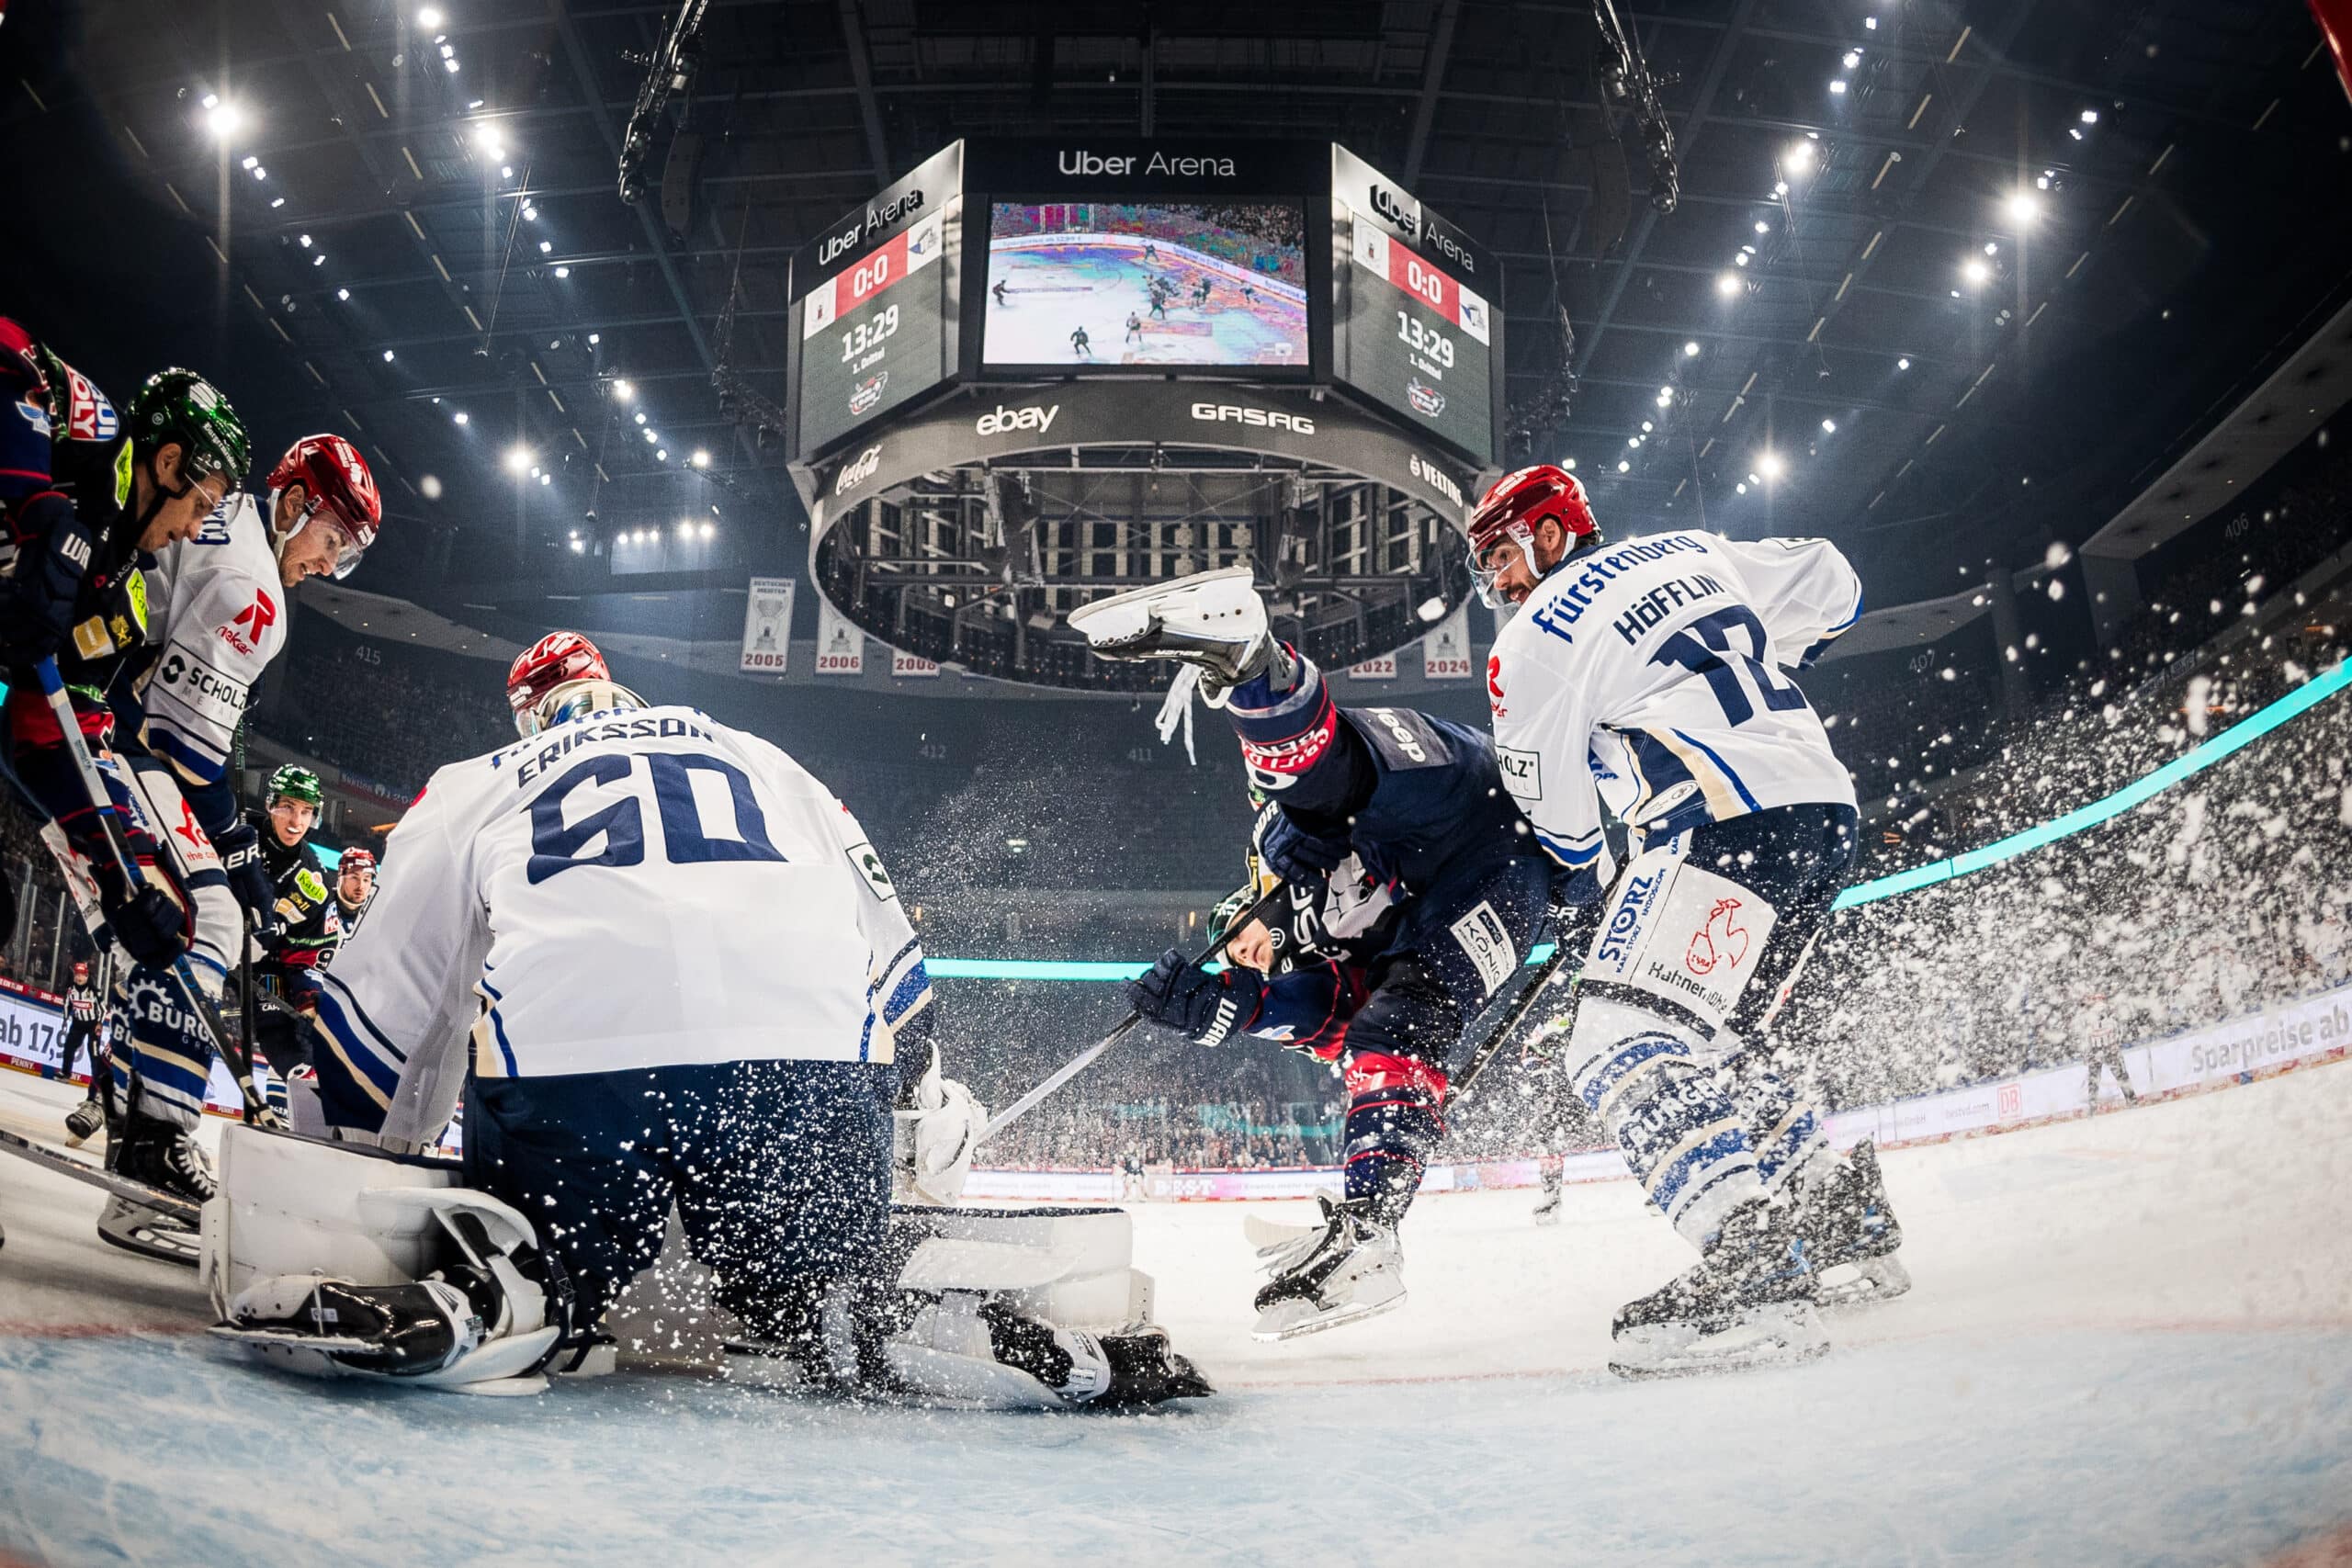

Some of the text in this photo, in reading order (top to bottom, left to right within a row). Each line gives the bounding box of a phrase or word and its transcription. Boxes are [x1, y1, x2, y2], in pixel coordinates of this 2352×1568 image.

[1058, 151, 1236, 175] Uber Arena
[819, 189, 923, 265] Uber Arena
[1371, 184, 1475, 273] Uber Arena
[853, 254, 888, 299] 0:0
[1408, 260, 1442, 305] 0:0
[842, 304, 899, 363] 13:29
[1397, 310, 1454, 368] 13:29
[74, 375, 96, 438] OLY
[976, 405, 1059, 435] ebay
[1191, 403, 1315, 434] GASAG
[1421, 459, 1464, 507] VELTINS
[2224, 513, 2250, 540] 406
[1612, 573, 1725, 646] HÖFFLIN
[356, 645, 381, 665] 415
[744, 653, 784, 667] 2005
[820, 655, 860, 669] 2006
[1427, 660, 1469, 672] 2024
[1908, 651, 1936, 672] 407
[187, 667, 247, 710] SCHOLZ
[517, 718, 714, 789] ERIKSSON
[921, 743, 947, 759] 412
[1127, 748, 1153, 762] 411
[1497, 752, 1531, 780] HOLZ
[520, 751, 788, 885] 60
[1598, 875, 1654, 962] STORZ
[0, 1014, 23, 1047] ab
[2191, 1004, 2350, 1074] Sparpreise ab
